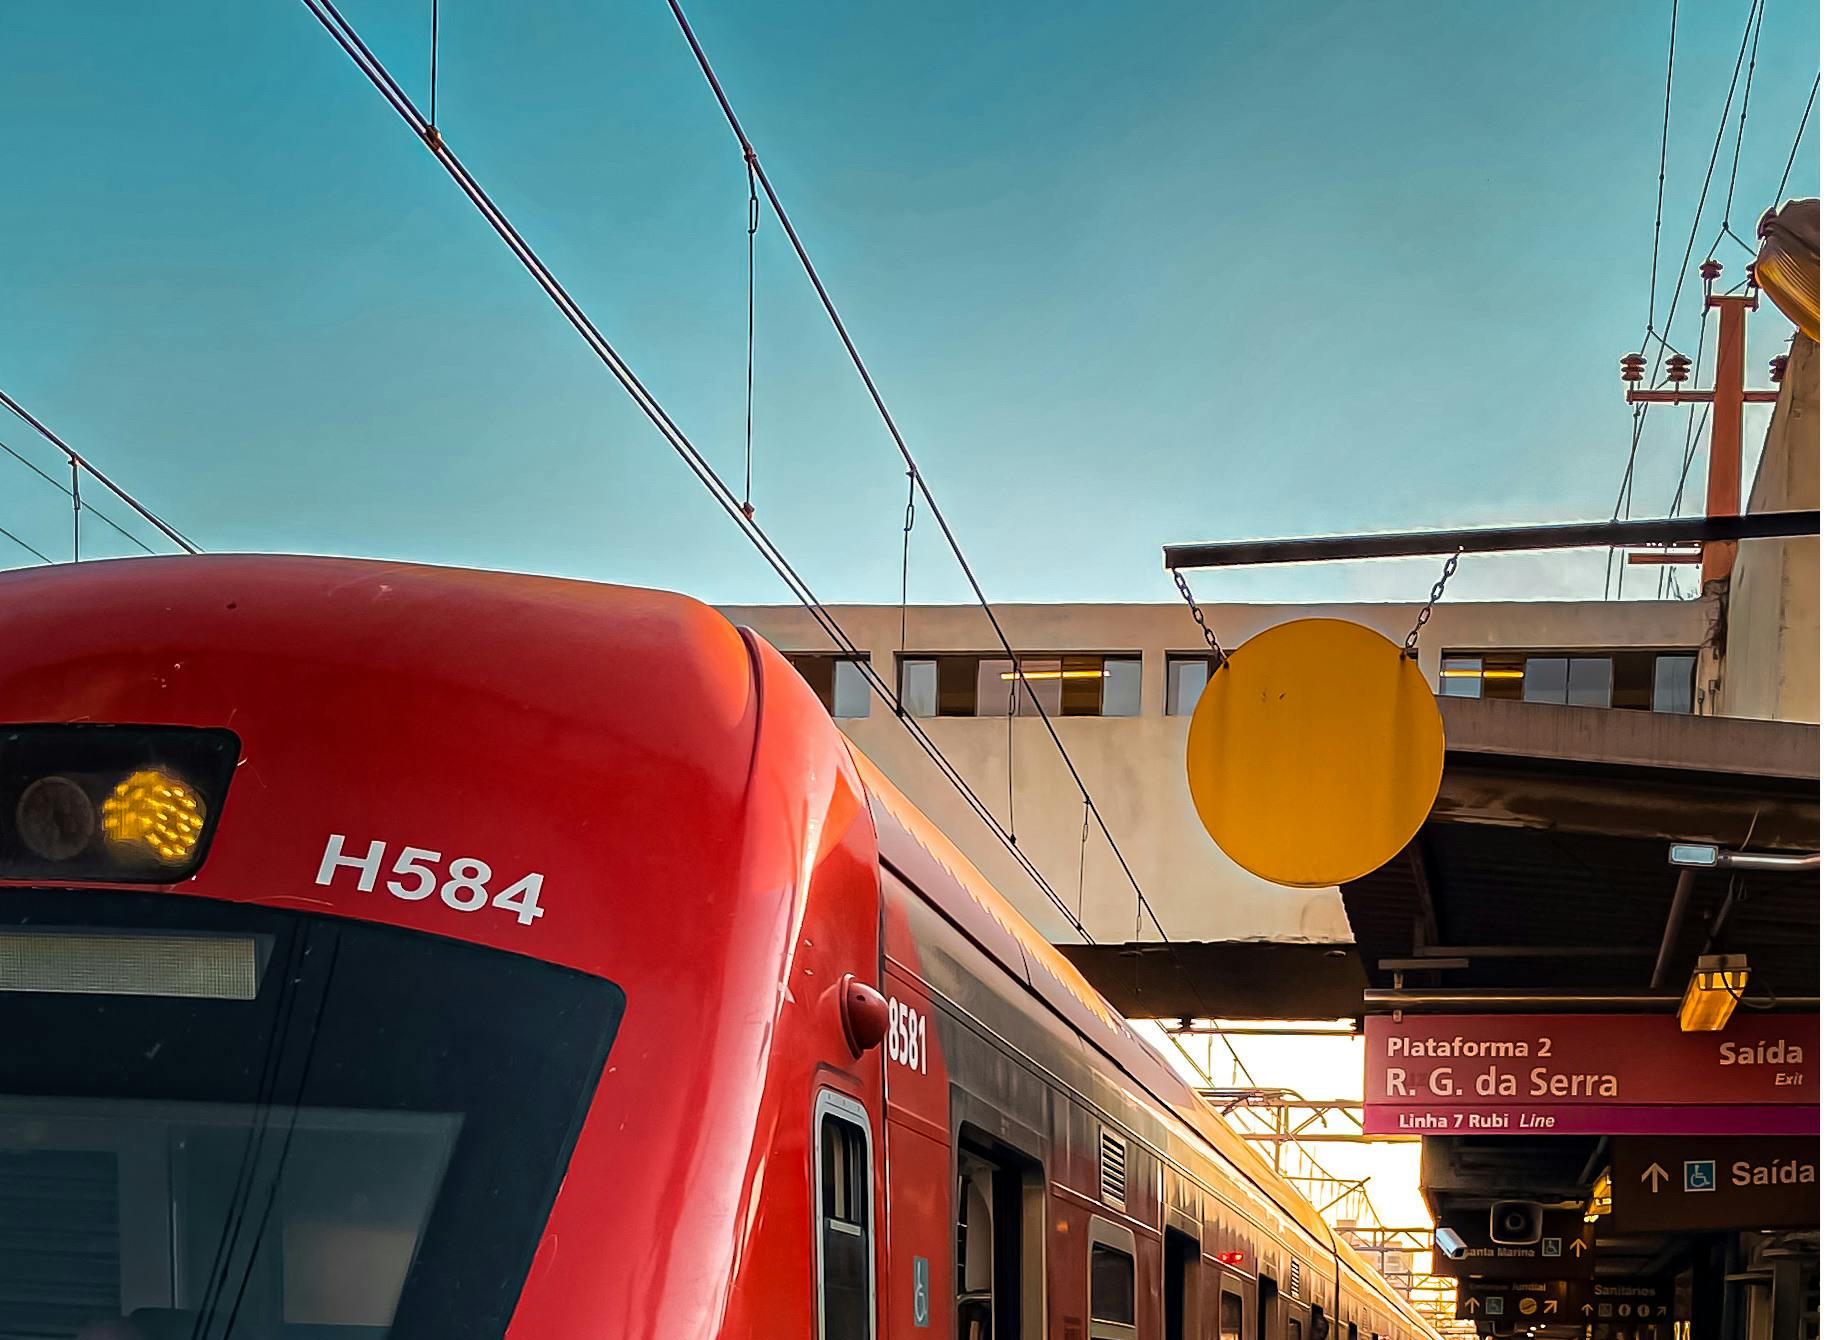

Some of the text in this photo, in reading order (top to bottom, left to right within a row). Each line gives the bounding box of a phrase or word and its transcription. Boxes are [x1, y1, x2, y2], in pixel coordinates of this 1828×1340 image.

[315, 833, 545, 926] H584
[888, 996, 927, 1075] 8581
[1387, 1037, 1552, 1057] Plataforma 2
[1719, 1040, 1803, 1065] Saída
[1386, 1065, 1618, 1096] R. G. da Serra
[1775, 1072, 1803, 1086] Exit
[1399, 1113, 1555, 1128] Linha 7 Rubi Line
[1731, 1159, 1815, 1186] Saída
